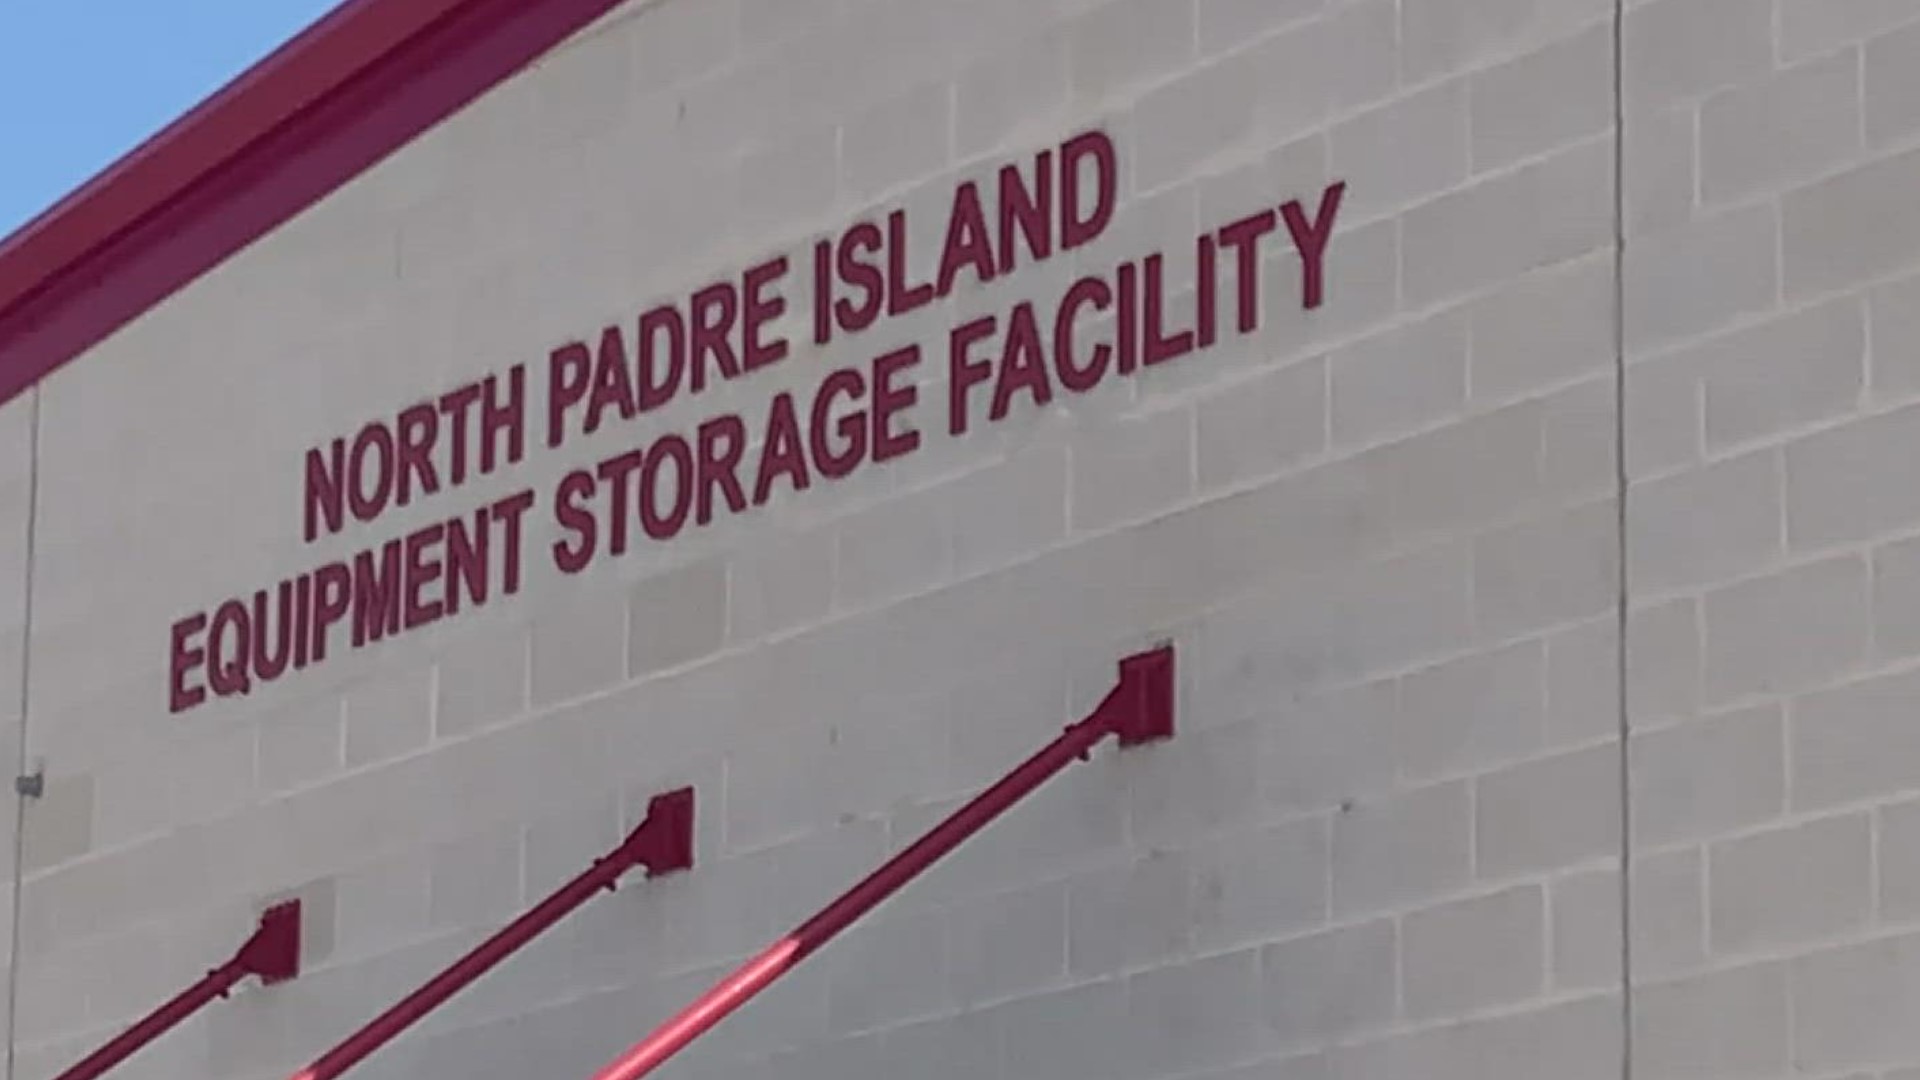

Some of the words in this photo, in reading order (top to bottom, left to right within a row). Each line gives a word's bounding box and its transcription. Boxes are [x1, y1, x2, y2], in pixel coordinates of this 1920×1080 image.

[168, 490, 535, 713] EQUIPMENT
[553, 344, 920, 574] STORAGE
[948, 182, 1346, 437] FACILITY
[303, 363, 526, 542] NORTH
[546, 256, 787, 449] PADRE
[813, 129, 1119, 344] ISLAND
